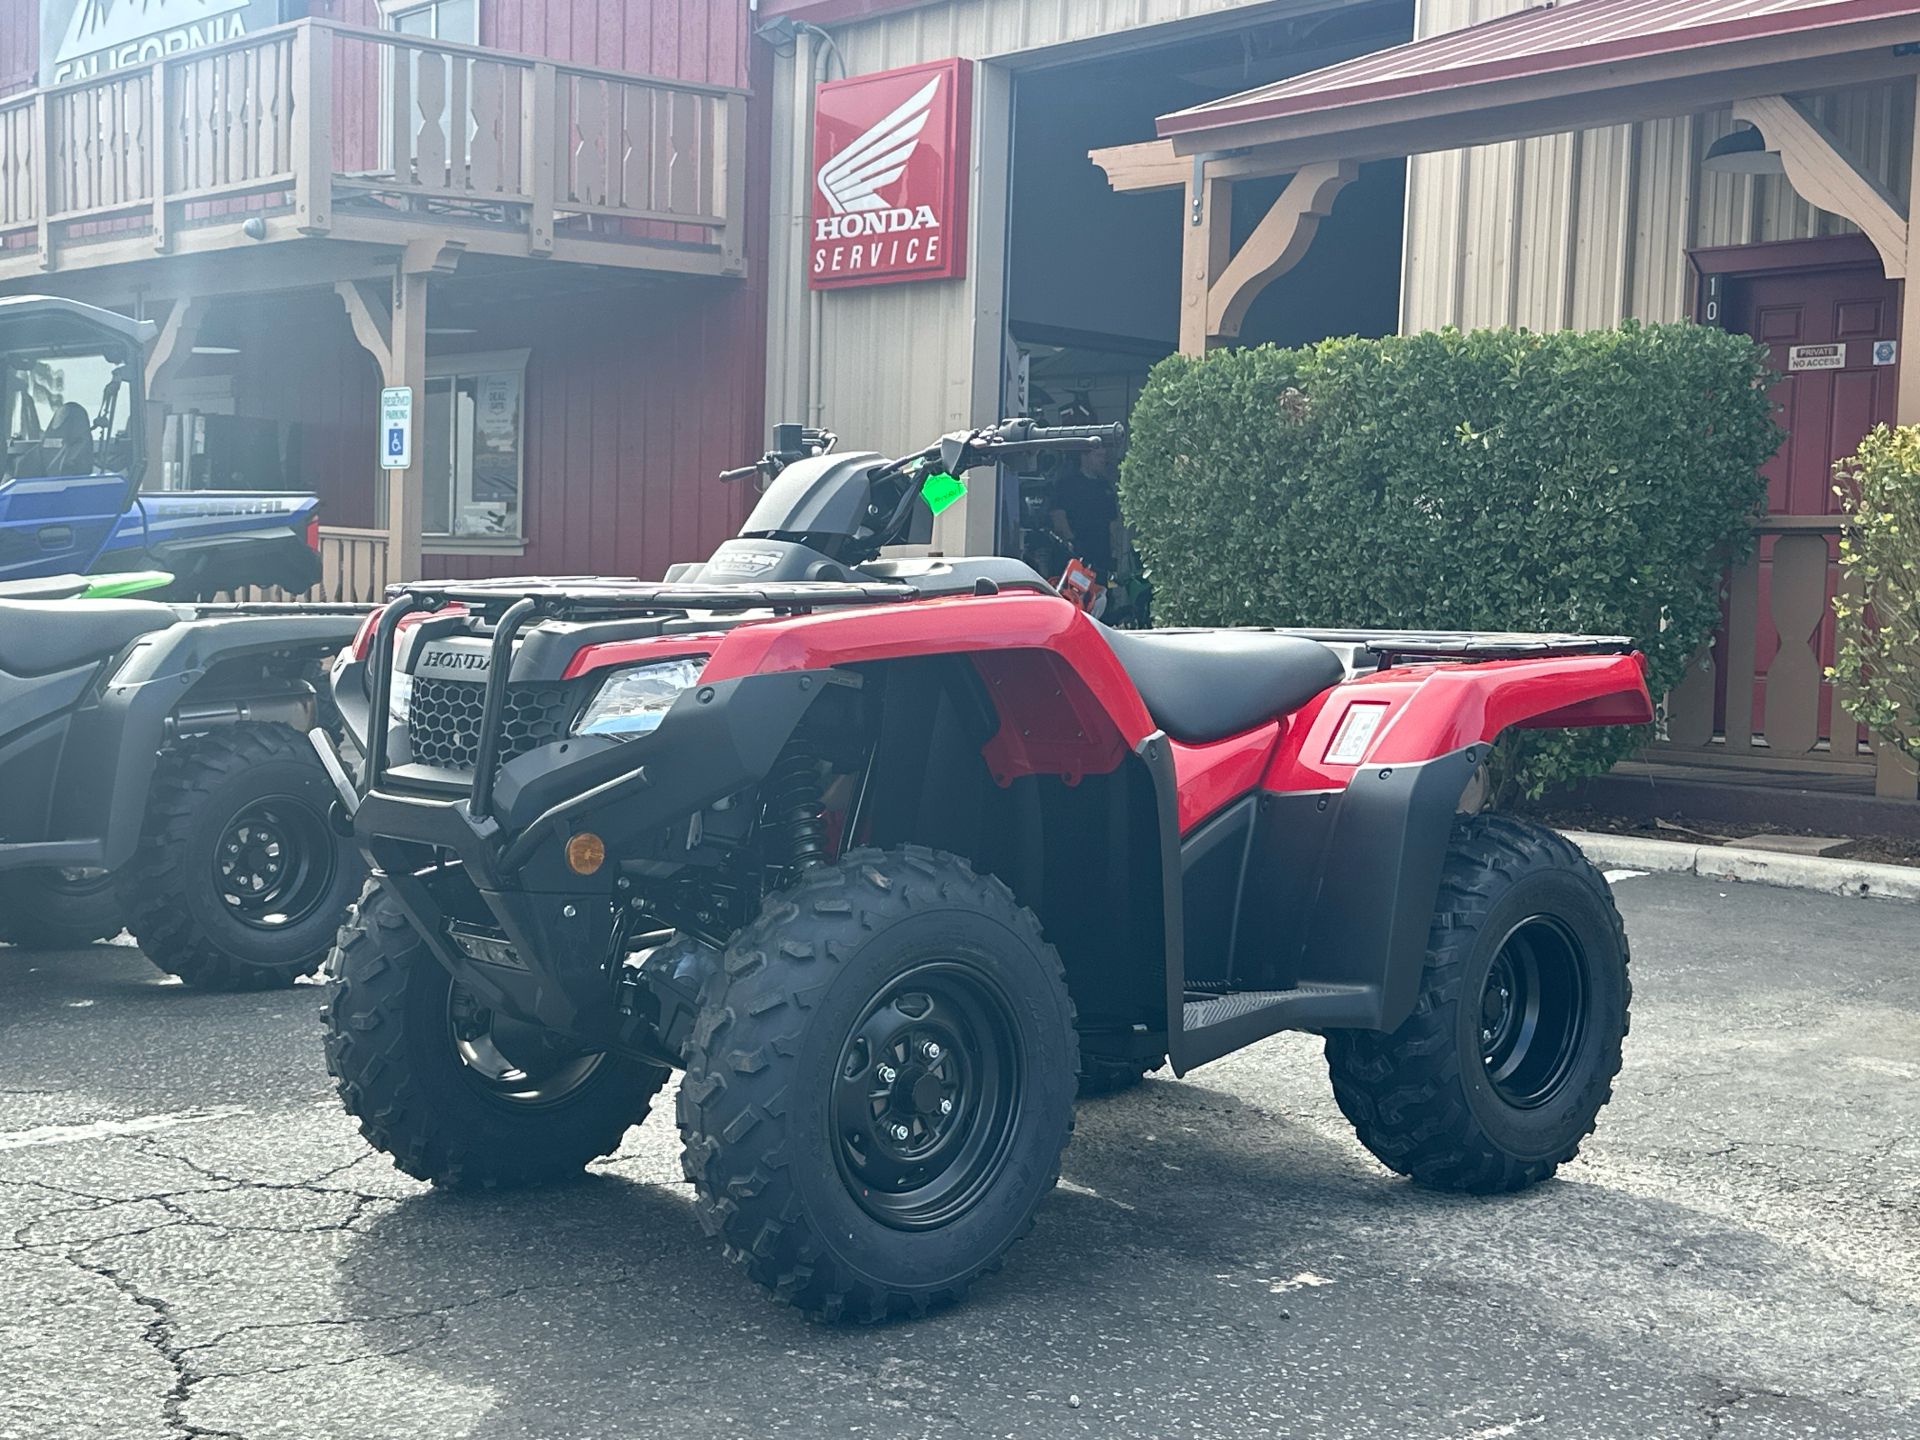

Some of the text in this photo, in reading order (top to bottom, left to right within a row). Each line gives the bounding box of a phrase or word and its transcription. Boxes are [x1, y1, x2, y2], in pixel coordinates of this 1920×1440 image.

[815, 205, 940, 241] HONDA
[814, 236, 939, 273] SERVICE
[1799, 347, 1835, 357] PRIVATE
[1792, 357, 1841, 369] NO ACCESS
[158, 500, 290, 516] GENERAL
